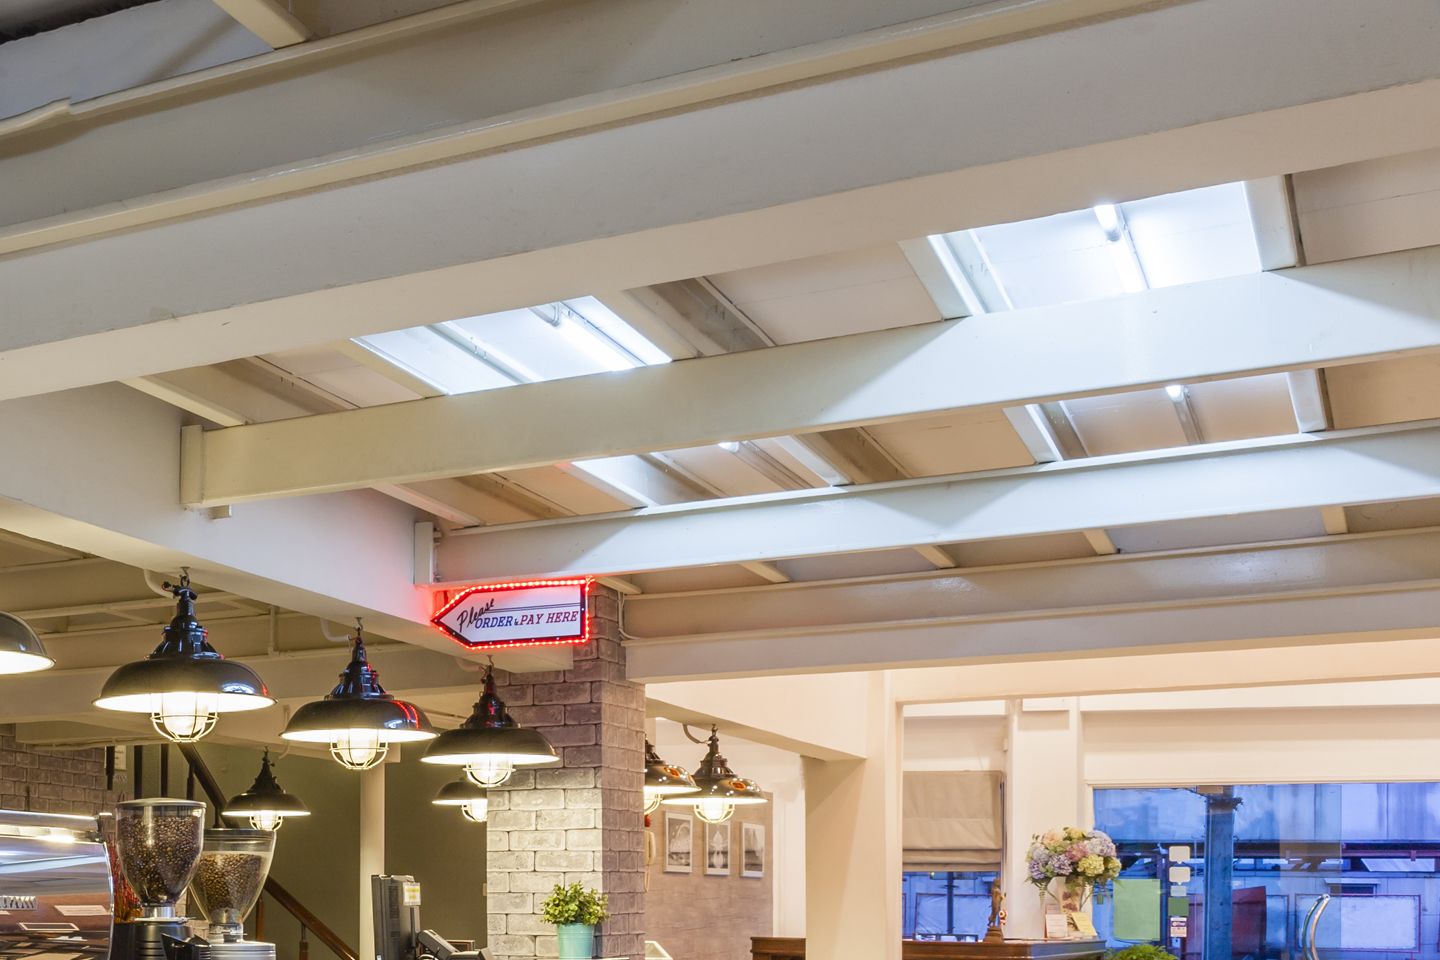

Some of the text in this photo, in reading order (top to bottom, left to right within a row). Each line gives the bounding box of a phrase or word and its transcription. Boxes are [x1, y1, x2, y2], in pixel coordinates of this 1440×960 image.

[456, 598, 495, 632] Please
[475, 616, 514, 629] ORDER
[519, 613, 543, 626] PAY
[546, 610, 579, 624] HERE
